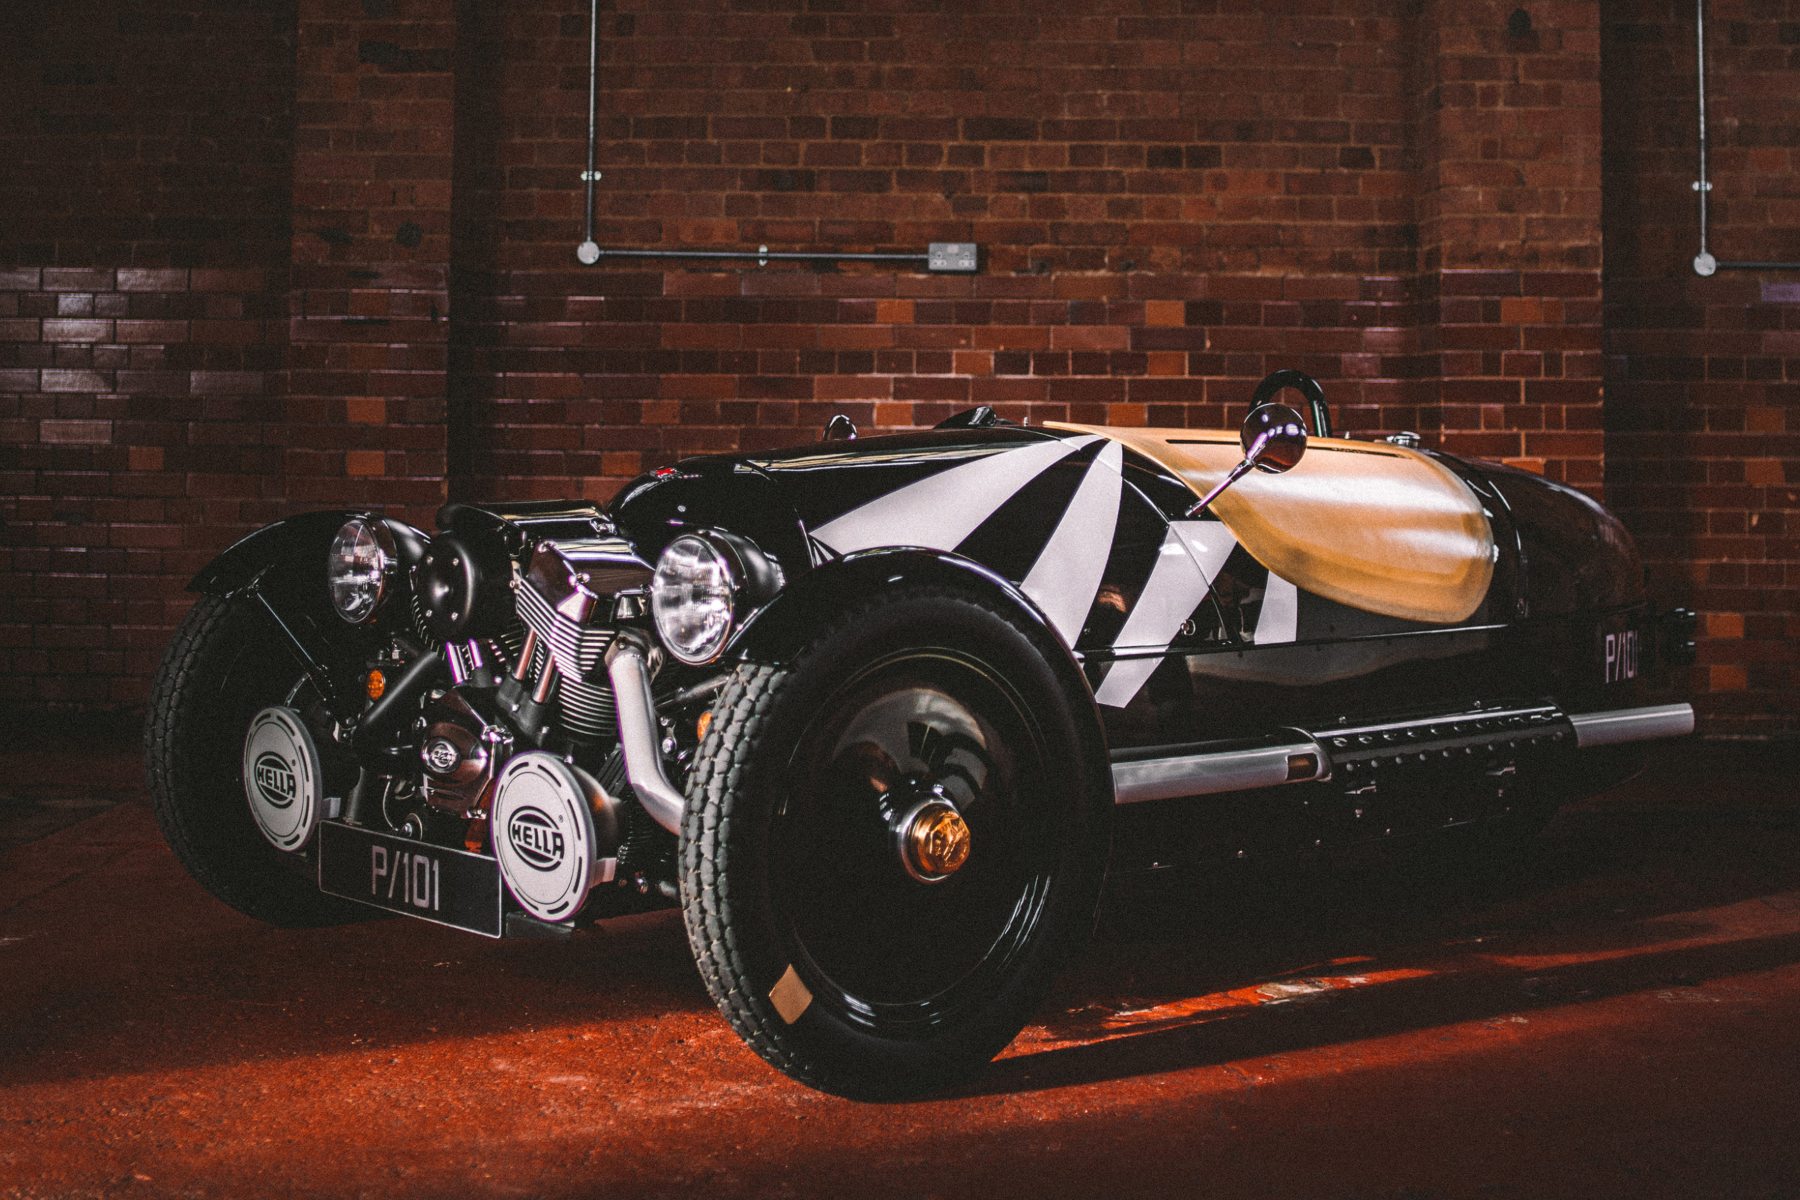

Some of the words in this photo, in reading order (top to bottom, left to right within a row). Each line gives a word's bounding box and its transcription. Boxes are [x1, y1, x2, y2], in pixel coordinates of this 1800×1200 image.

[257, 766, 297, 799] HELLA
[511, 823, 565, 860] HELLA
[371, 845, 439, 911] P/101
